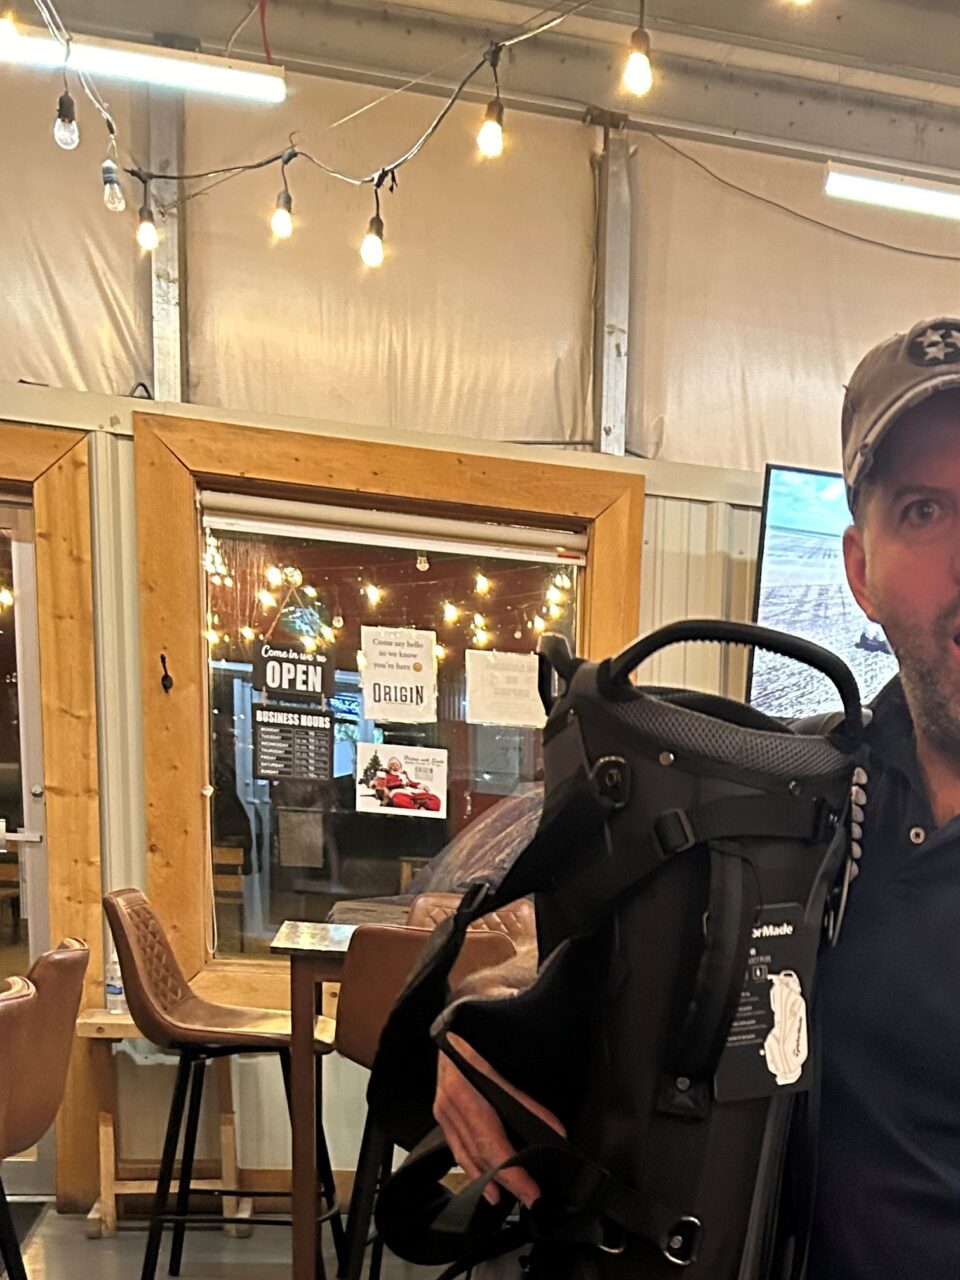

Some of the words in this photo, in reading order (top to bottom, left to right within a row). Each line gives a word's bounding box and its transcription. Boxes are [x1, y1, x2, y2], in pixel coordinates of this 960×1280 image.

[373, 638, 393, 646] Come
[266, 660, 322, 693] OPEN
[373, 683, 424, 705] ORIGIN
[256, 710, 300, 726] BUSINESS
[300, 714, 331, 729] HOURS
